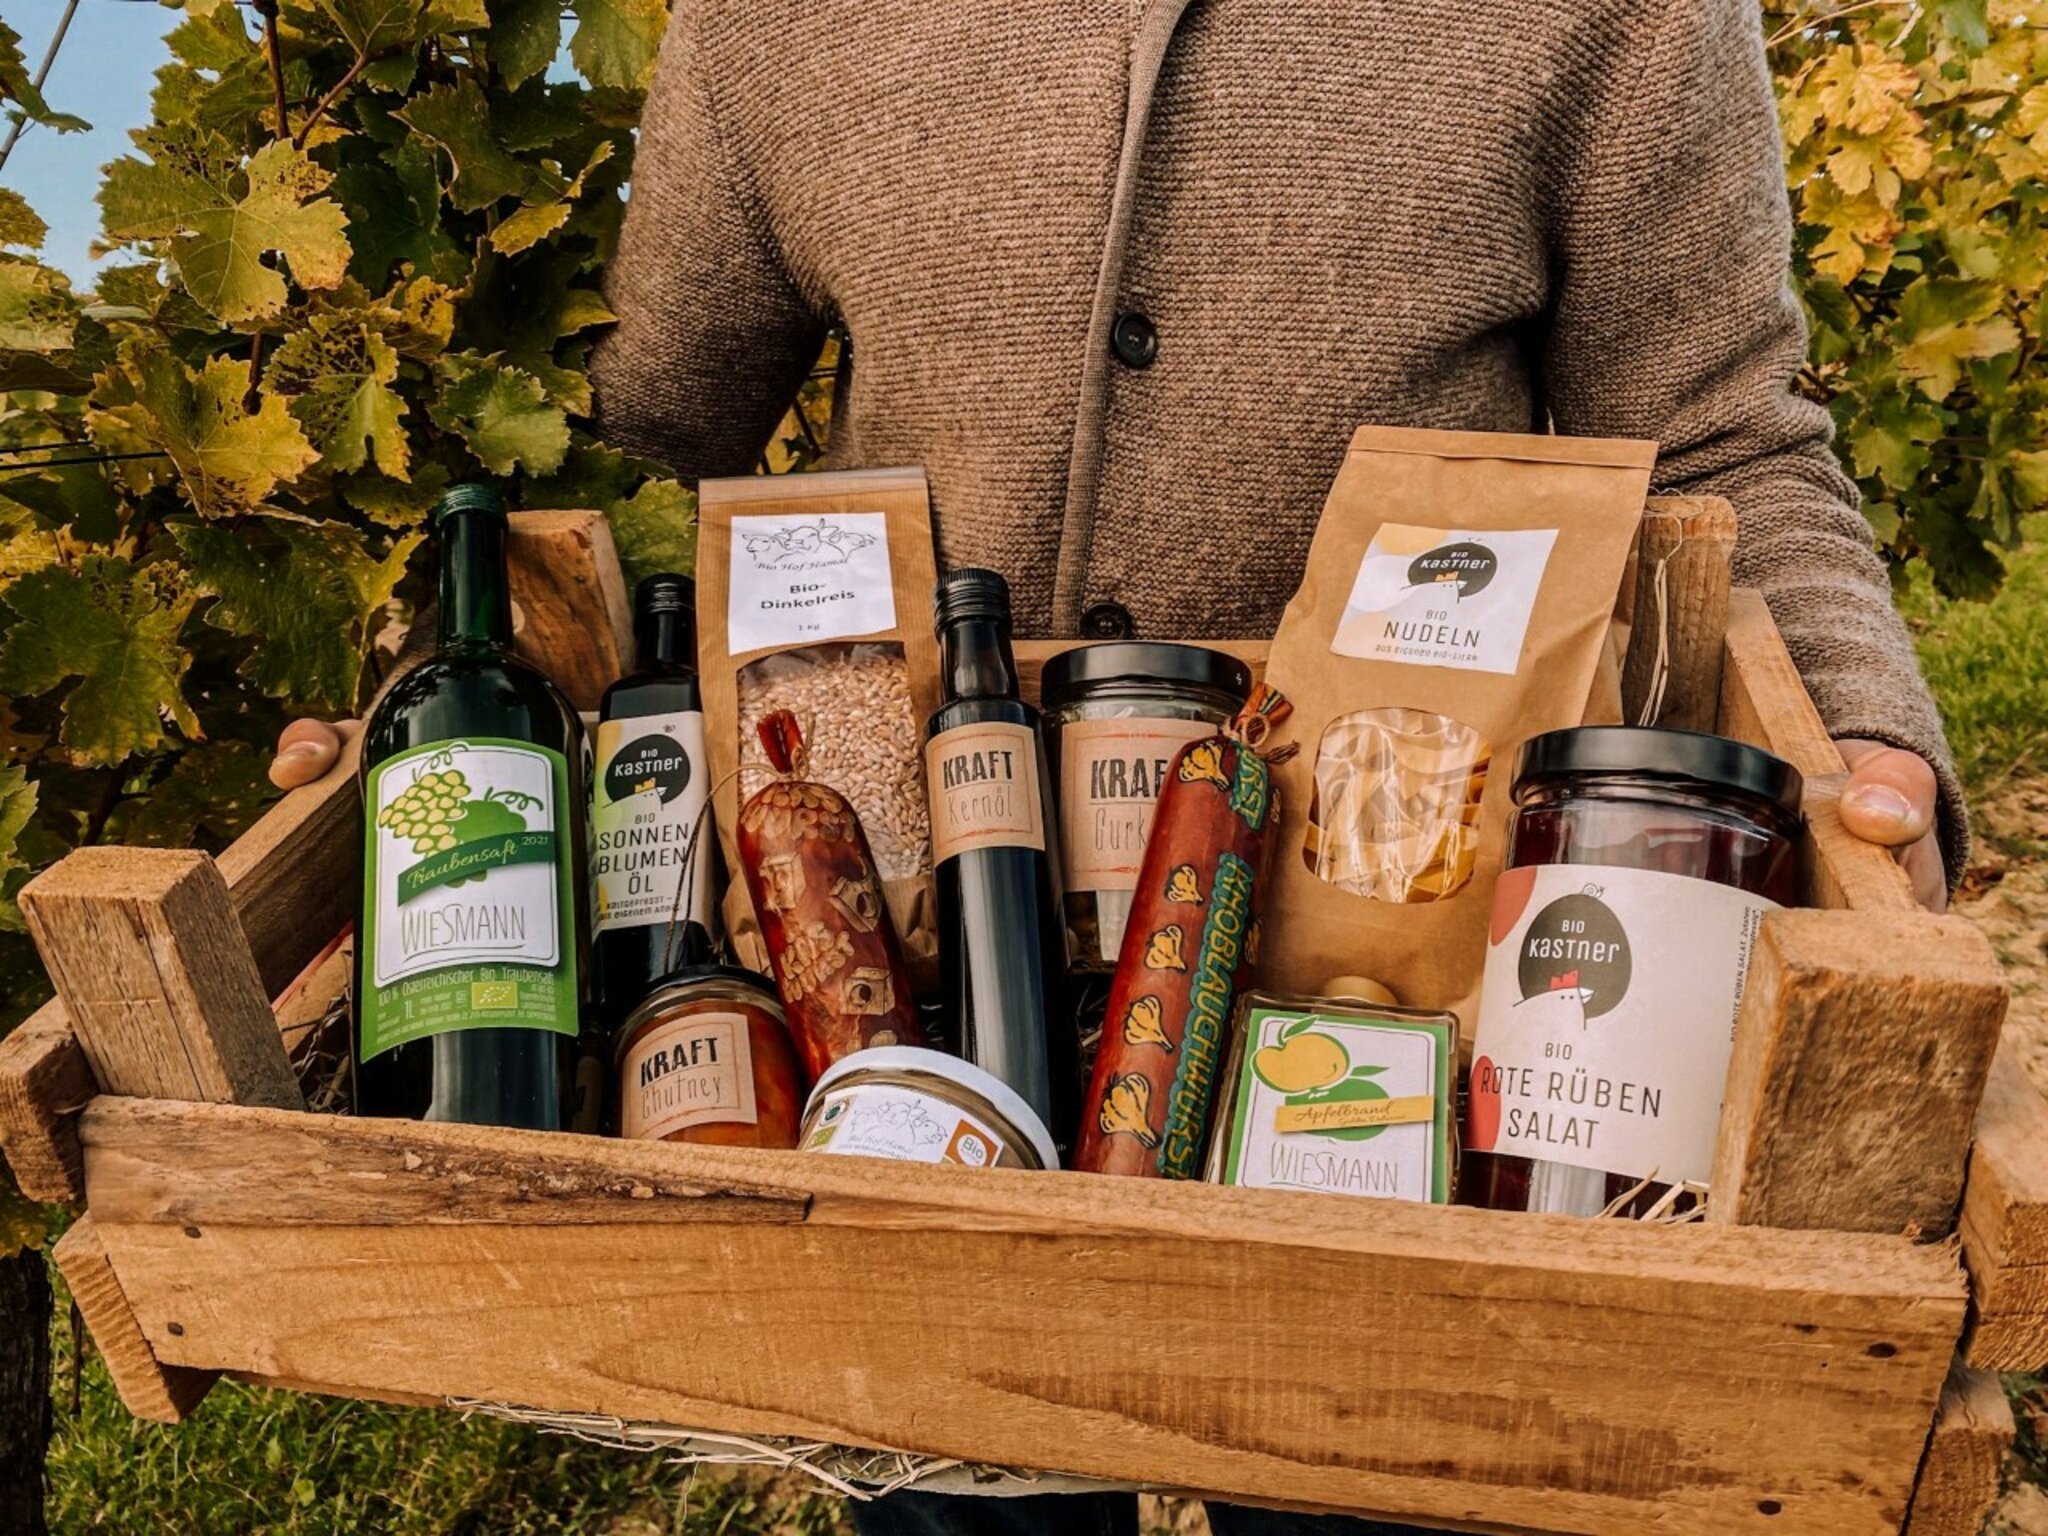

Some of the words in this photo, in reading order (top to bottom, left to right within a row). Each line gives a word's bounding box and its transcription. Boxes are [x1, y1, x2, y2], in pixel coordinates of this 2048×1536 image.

[1450, 550, 1469, 559] BIO
[760, 588, 856, 610] Dinkelreis
[789, 582, 826, 595] Bio-
[1424, 609, 1448, 621] BIO
[1383, 620, 1481, 649] NUDELN
[640, 748, 659, 759] BIO
[943, 750, 1013, 790] KRAFT
[1090, 759, 1169, 799] KRAF
[634, 812, 656, 825] BIO
[947, 785, 1013, 827] Kernöl
[598, 822, 690, 851] SONNEN
[1094, 807, 1148, 851] Gurk
[405, 838, 518, 889] Traubensaft
[598, 846, 688, 875] BLUMEN
[628, 871, 654, 895] ÖL
[400, 903, 527, 955] WIESMANN
[1561, 919, 1586, 934] BIO
[640, 1036, 719, 1089] KRAFT
[1544, 1042, 1573, 1061] BIO
[641, 1071, 722, 1121] Chutney
[1480, 1066, 1534, 1098] ROTE
[1547, 1067, 1662, 1119] RÜBEN
[1294, 1101, 1395, 1126] Apfelbrand
[1507, 1108, 1600, 1150] SALAT
[962, 1136, 984, 1160] Bio
[1269, 1140, 1399, 1194] WIESMANN
